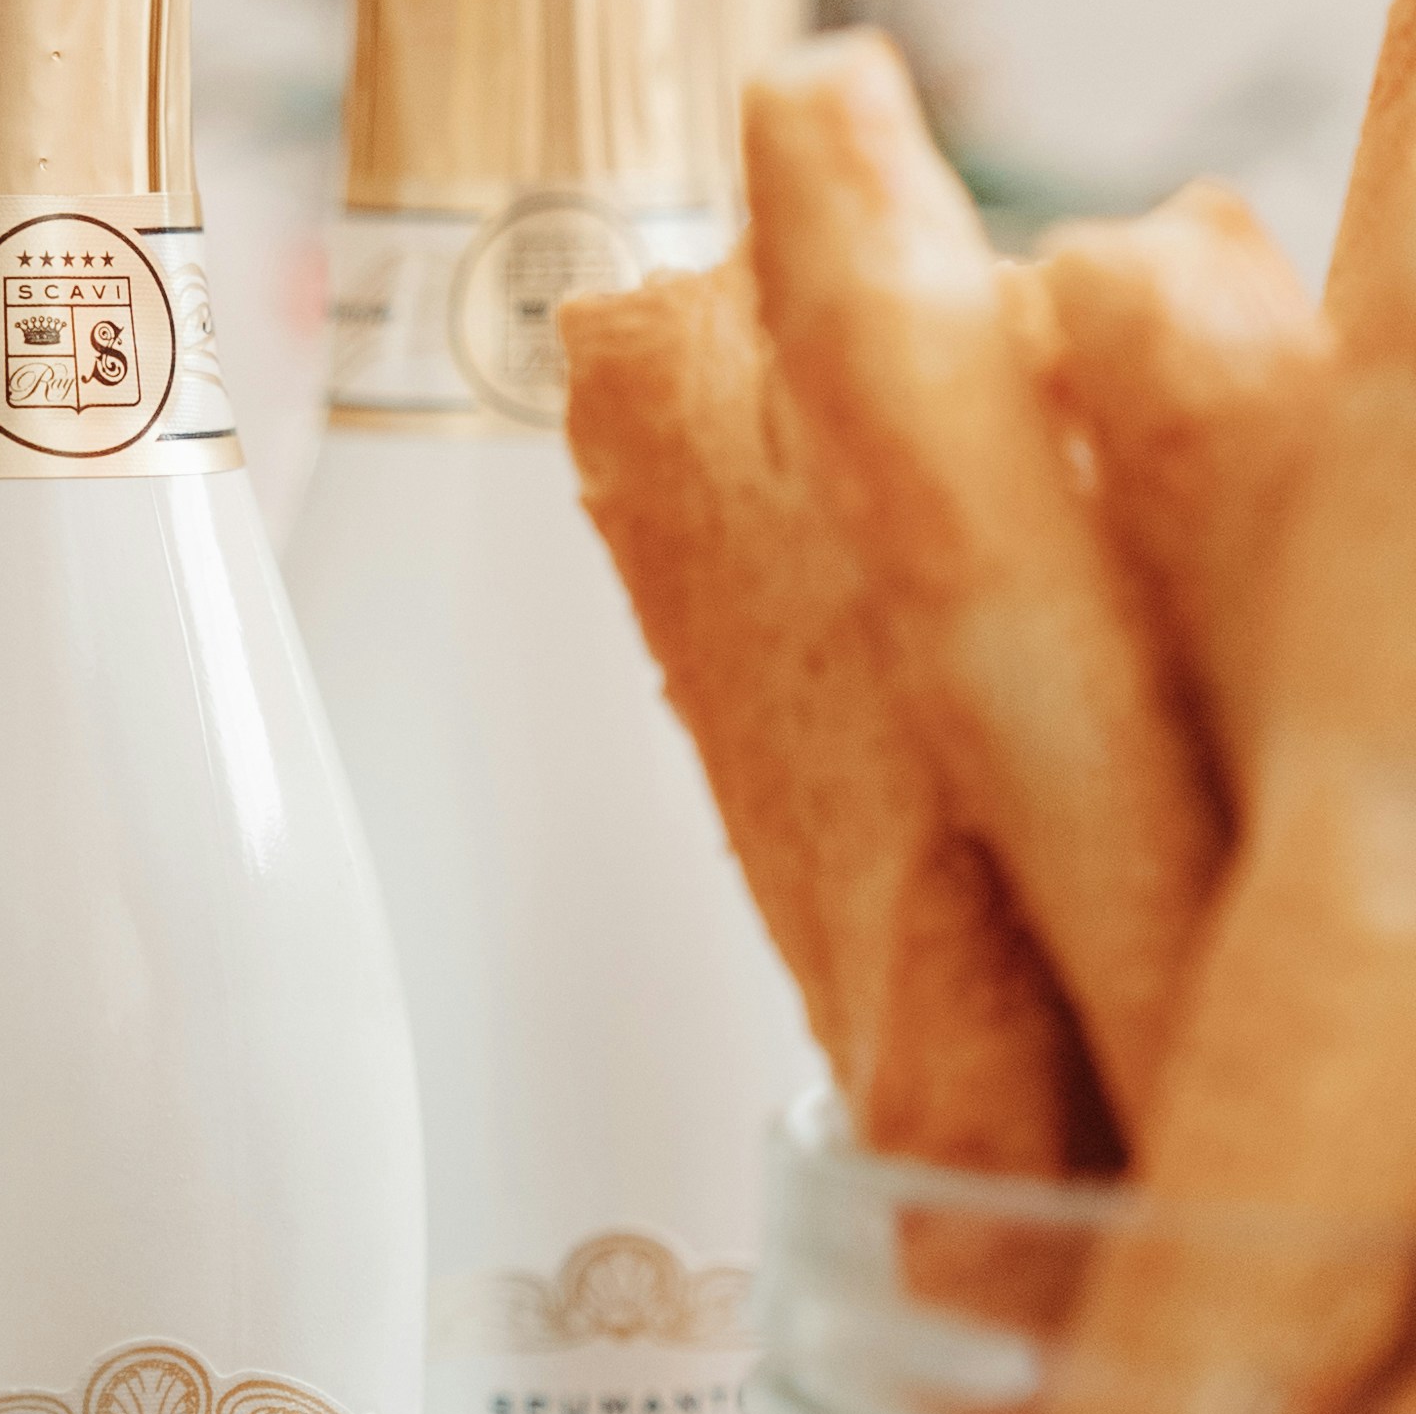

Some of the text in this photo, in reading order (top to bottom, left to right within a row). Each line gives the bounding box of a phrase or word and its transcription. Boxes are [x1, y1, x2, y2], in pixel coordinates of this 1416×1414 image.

[17, 284, 122, 300] SCAVI
[81, 320, 128, 387] S
[9, 362, 75, 403] Ray
